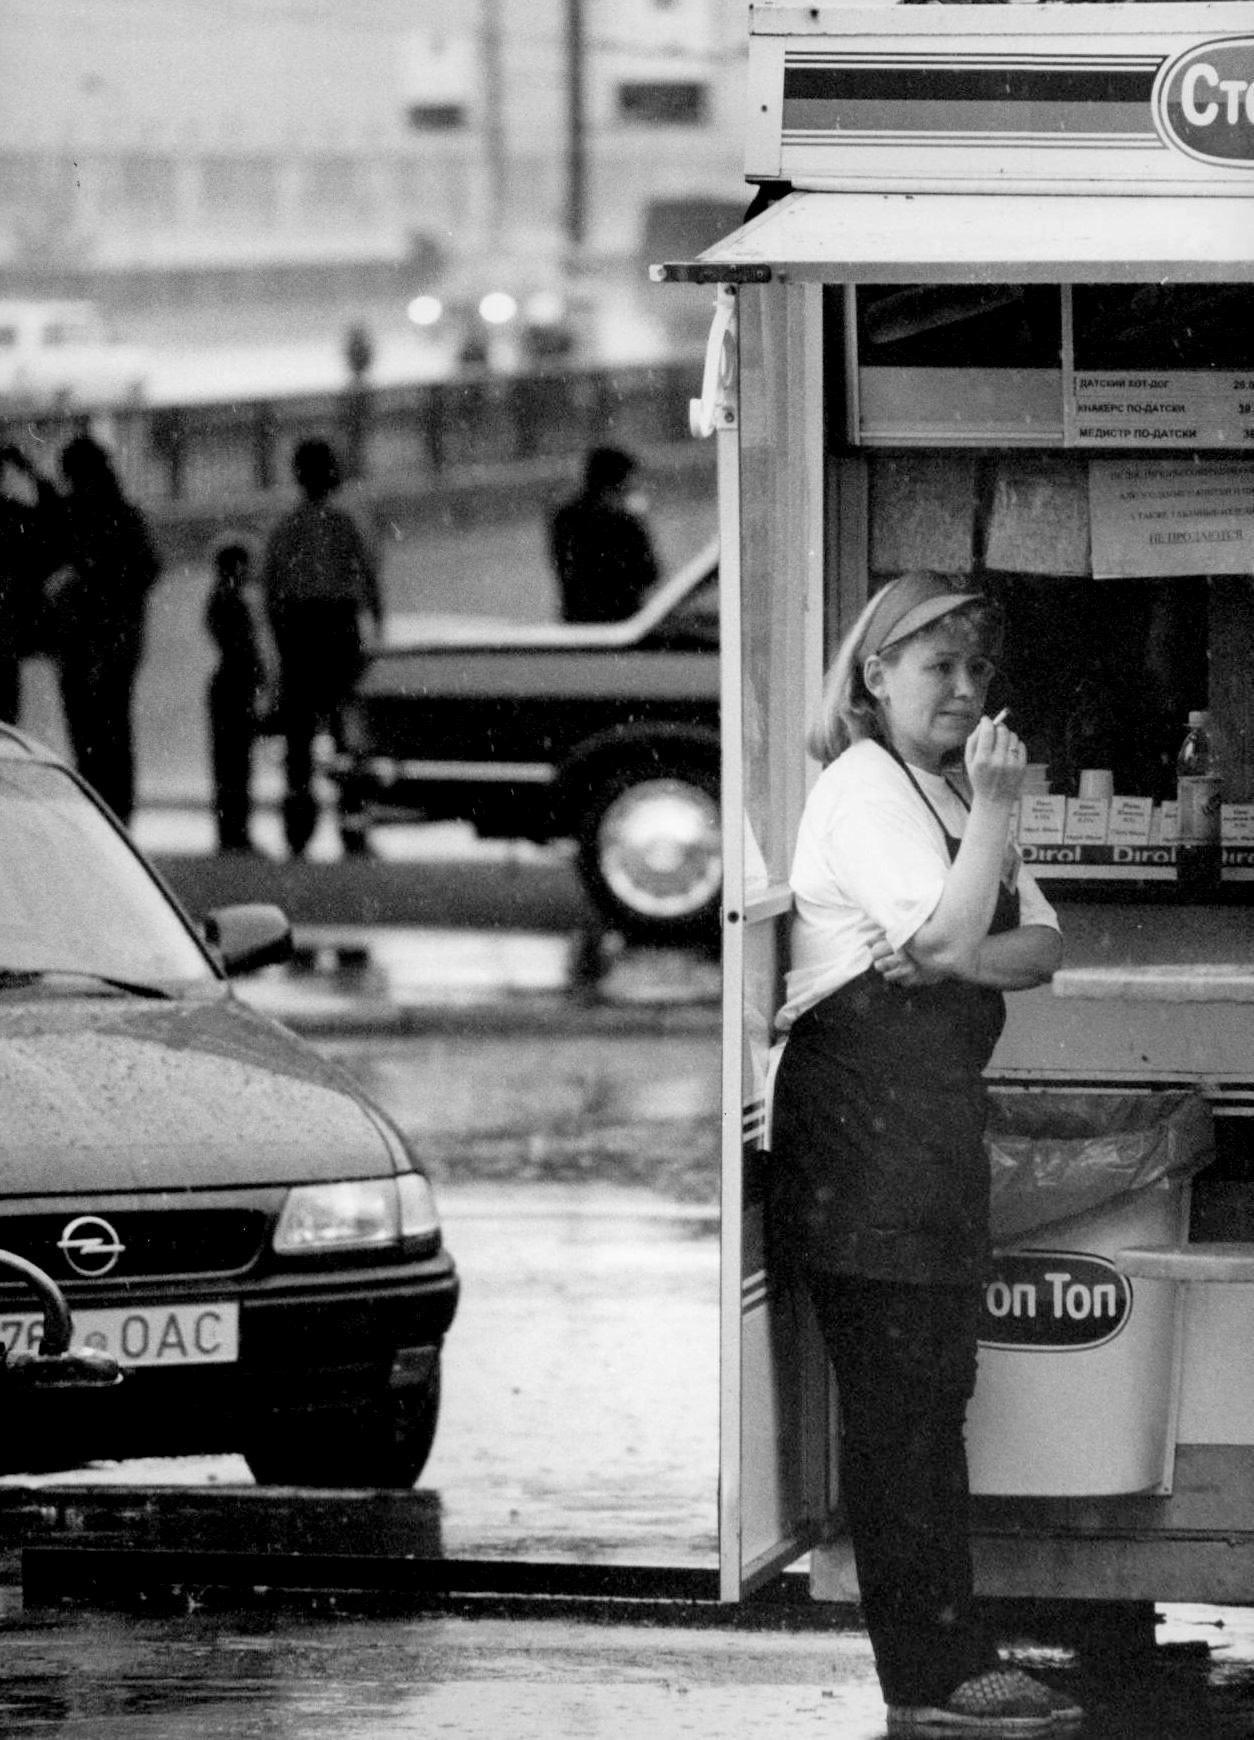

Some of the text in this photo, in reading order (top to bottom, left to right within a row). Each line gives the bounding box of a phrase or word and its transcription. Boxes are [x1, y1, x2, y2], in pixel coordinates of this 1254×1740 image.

[1126, 404, 1186, 414] ПО-ДАТСКИ
[1133, 428, 1197, 439] ПО-ДАТСКИ
[1020, 845, 1081, 861] Dirol
[1112, 845, 1177, 863] Dirol
[984, 1272, 1117, 1320] оп Топ
[120, 1310, 222, 1359] OAC
